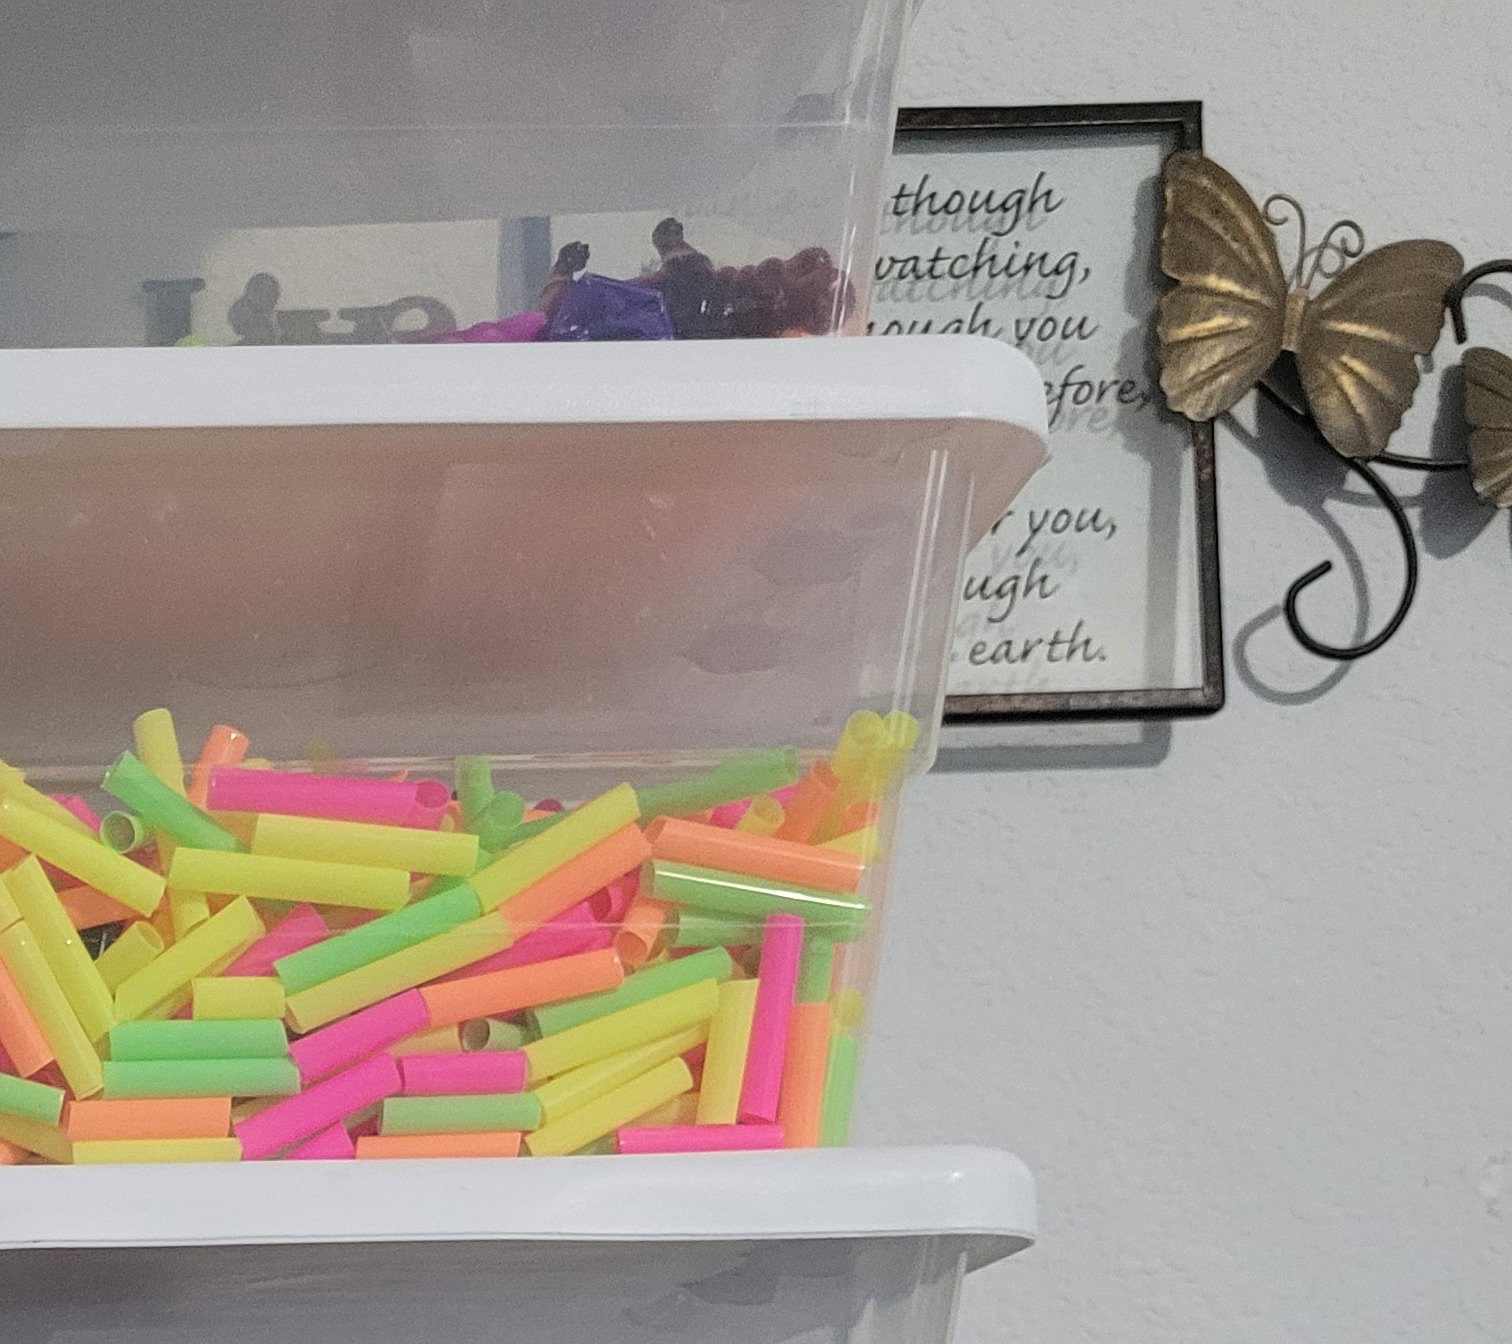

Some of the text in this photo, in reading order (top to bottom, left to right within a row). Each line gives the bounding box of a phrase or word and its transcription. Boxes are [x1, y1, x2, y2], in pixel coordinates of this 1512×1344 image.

[890, 170, 1066, 237] though
[1013, 315, 1099, 342] you
[1015, 507, 1117, 558] you,
[968, 617, 1107, 666] earth.
